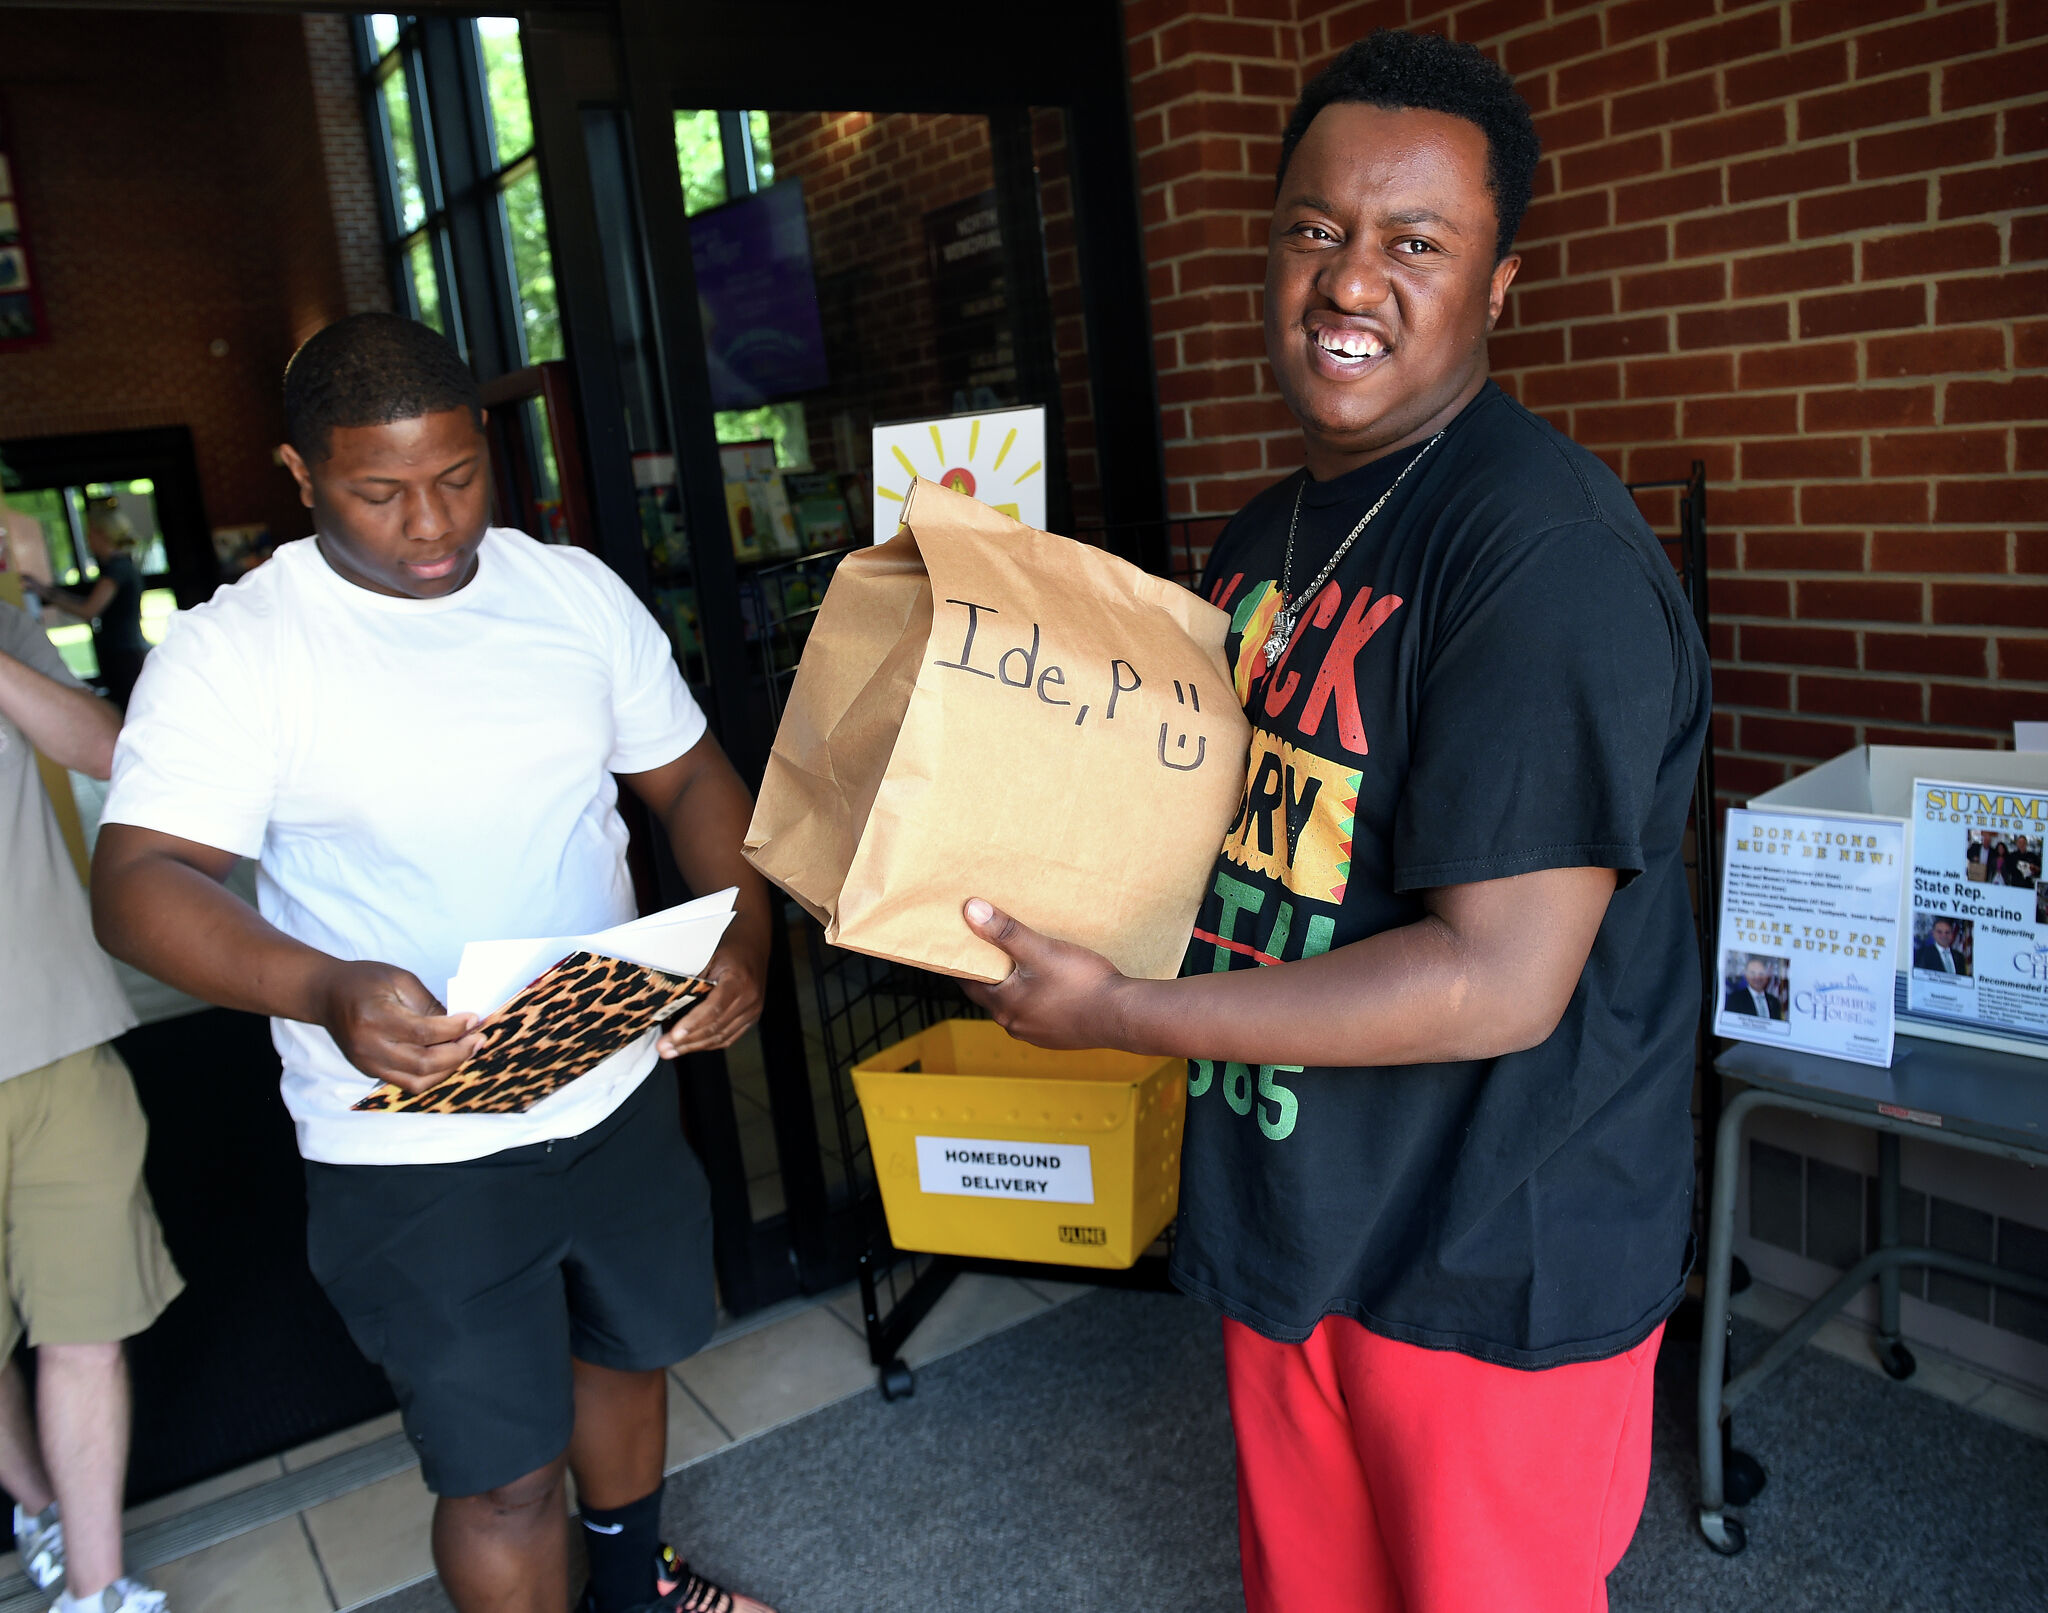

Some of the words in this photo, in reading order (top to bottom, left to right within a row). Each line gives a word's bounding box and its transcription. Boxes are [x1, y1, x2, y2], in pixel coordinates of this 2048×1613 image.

[934, 599, 1090, 726] Ide,
[1926, 789, 2048, 821] SUMM
[1926, 811, 2023, 830] CLOTHING
[1753, 826, 1877, 848] DONATIONS
[1736, 839, 1790, 856] MUST
[1803, 846, 1827, 859] BE
[1839, 849, 1894, 865] NEW!
[1914, 866, 1940, 876] Please
[1943, 870, 1960, 879] Join
[1914, 878, 1950, 894] State
[1955, 883, 1985, 901] Rep.
[1914, 894, 1947, 911] Dave
[1952, 900, 2022, 921] Yaccarino
[1734, 917, 1793, 934] THANK
[1803, 927, 1839, 940] YOU
[1849, 932, 1886, 948] FOR
[1991, 925, 2035, 940] Supporting
[1737, 931, 1783, 946] YOUR
[1793, 939, 1881, 960] SUPPORT
[1979, 975, 2042, 992] Recommended
[945, 1149, 1061, 1169] HOMEBOUND
[961, 1175, 1048, 1193] DELIVERY
[1058, 1225, 1107, 1246] ULINE
